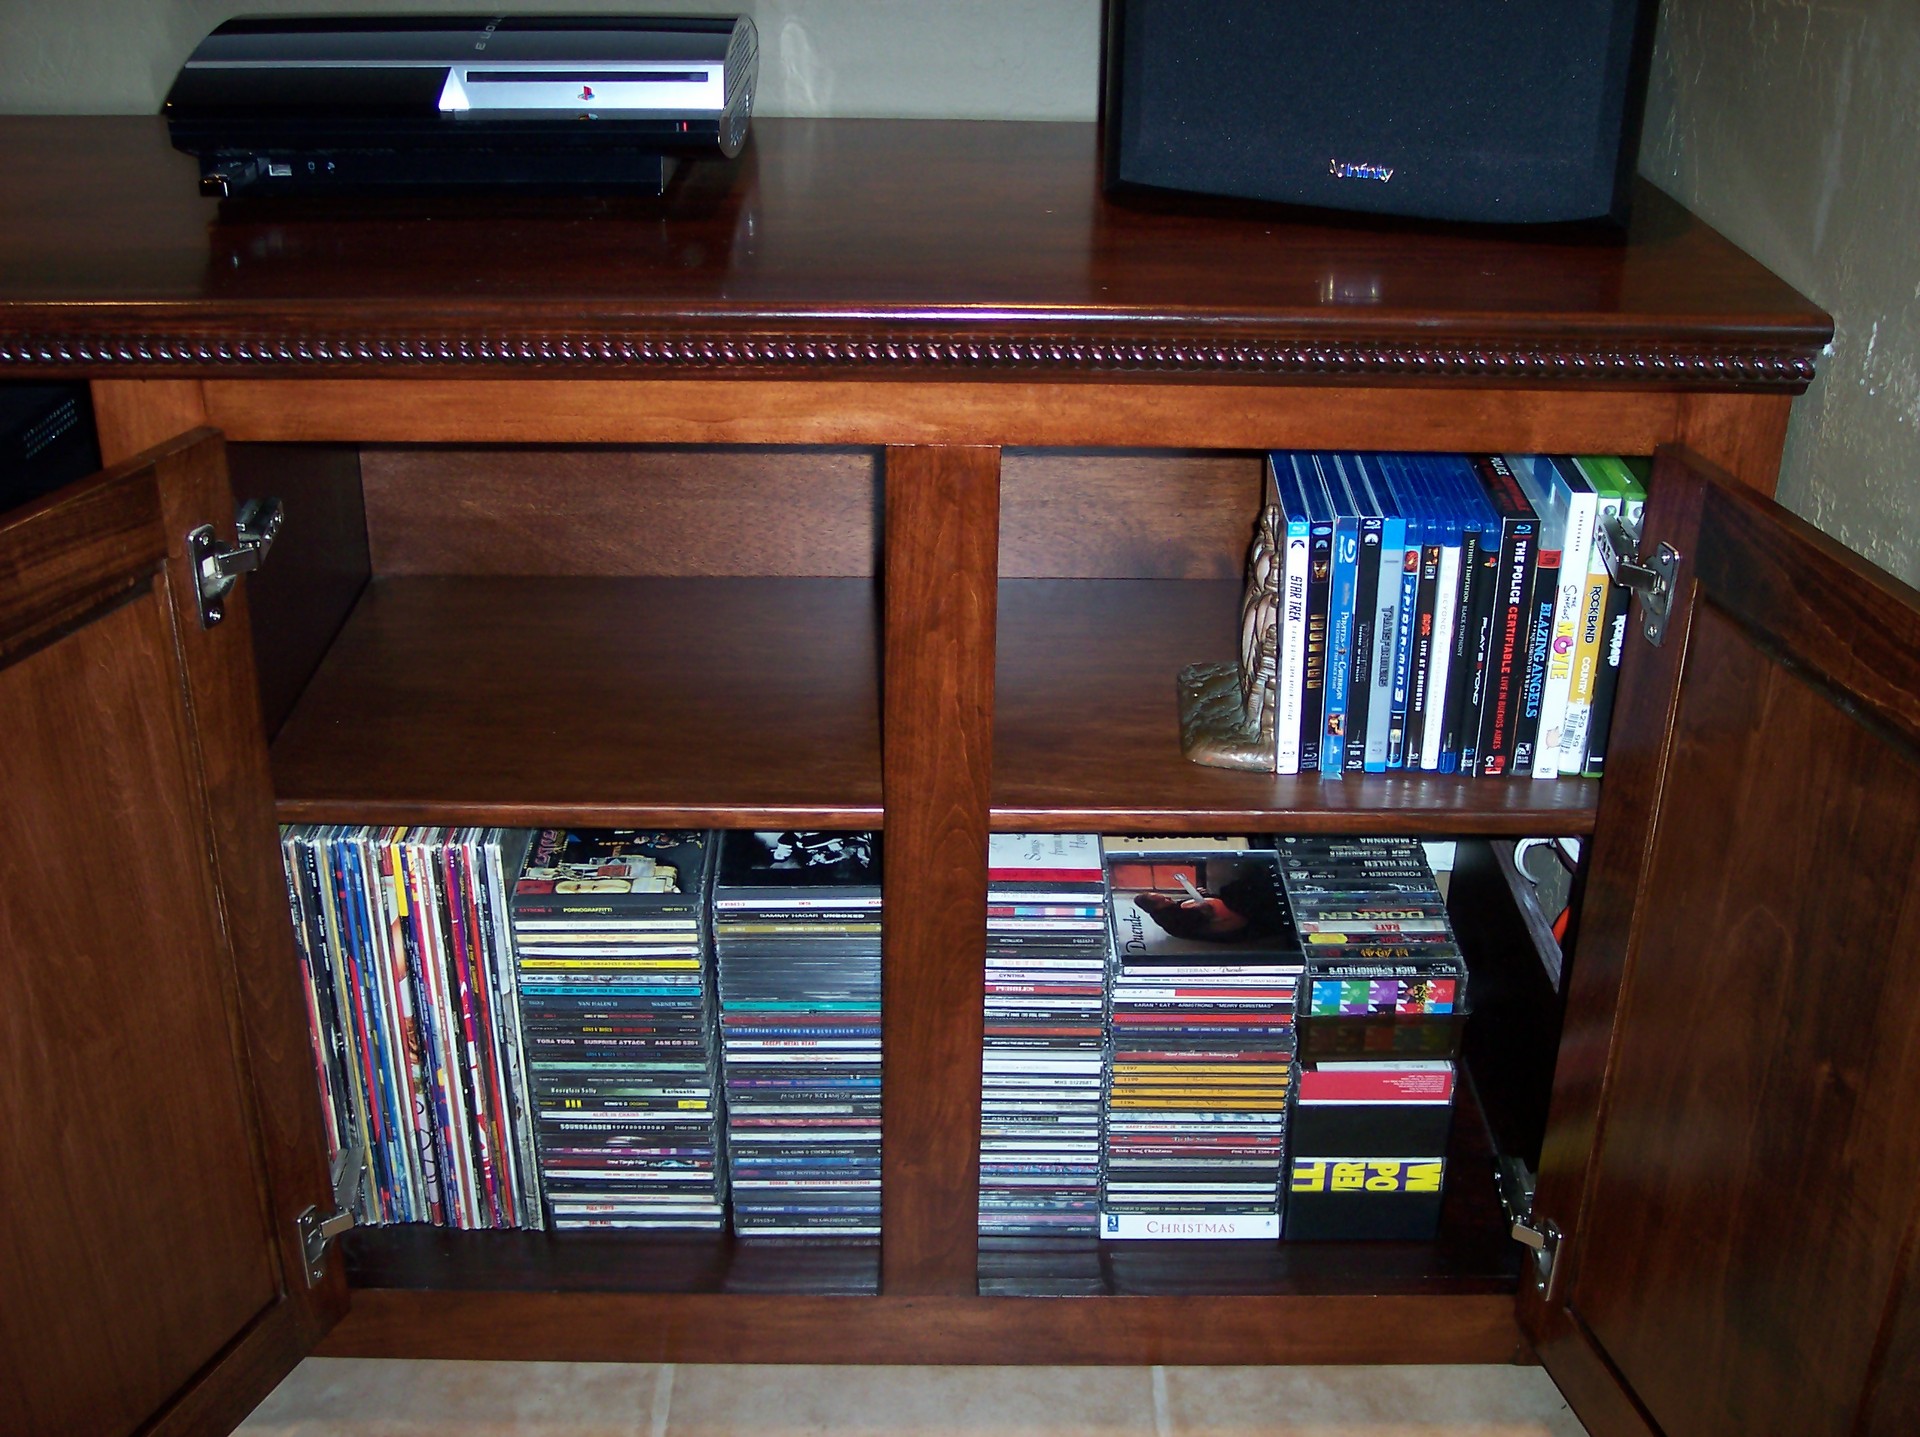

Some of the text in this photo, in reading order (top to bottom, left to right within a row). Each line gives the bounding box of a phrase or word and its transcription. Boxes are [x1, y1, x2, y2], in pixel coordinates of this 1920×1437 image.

[1513, 540, 1527, 563] THE
[1289, 575, 1302, 599] STAR
[1508, 565, 1525, 605] POLICE
[1457, 539, 1476, 657] WITHIN TEMPTATION BLACK SYMPHONY
[1570, 595, 1578, 608] THE
[1288, 600, 1302, 622] TREK
[1501, 606, 1520, 674] CERTIFIABLE
[1549, 584, 1578, 680] SIMPSONS MOVIE
[1336, 611, 1349, 700] PIRATES CARIBBEAN
[1378, 605, 1394, 687] TRANSFORMERS
[1420, 640, 1428, 657] LIVE
[1525, 602, 1553, 719] BLAZING ANGELS
[1500, 676, 1510, 691] LIVE
[1577, 656, 1591, 695] COUNTRY
[1394, 687, 1404, 702] 3
[1495, 700, 1507, 729] BUENOS
[1492, 729, 1504, 750] AIRES
[1363, 860, 1397, 868] HALEN
[1318, 911, 1424, 920] DOKKEN
[1122, 907, 1147, 954] Duende
[1374, 923, 1401, 931] RATT
[1328, 966, 1417, 975] RICK SPRINGFIELD'S
[560, 1123, 612, 1131] SOUNDGARDEN
[1146, 1220, 1236, 1234] CHRISTMAS
